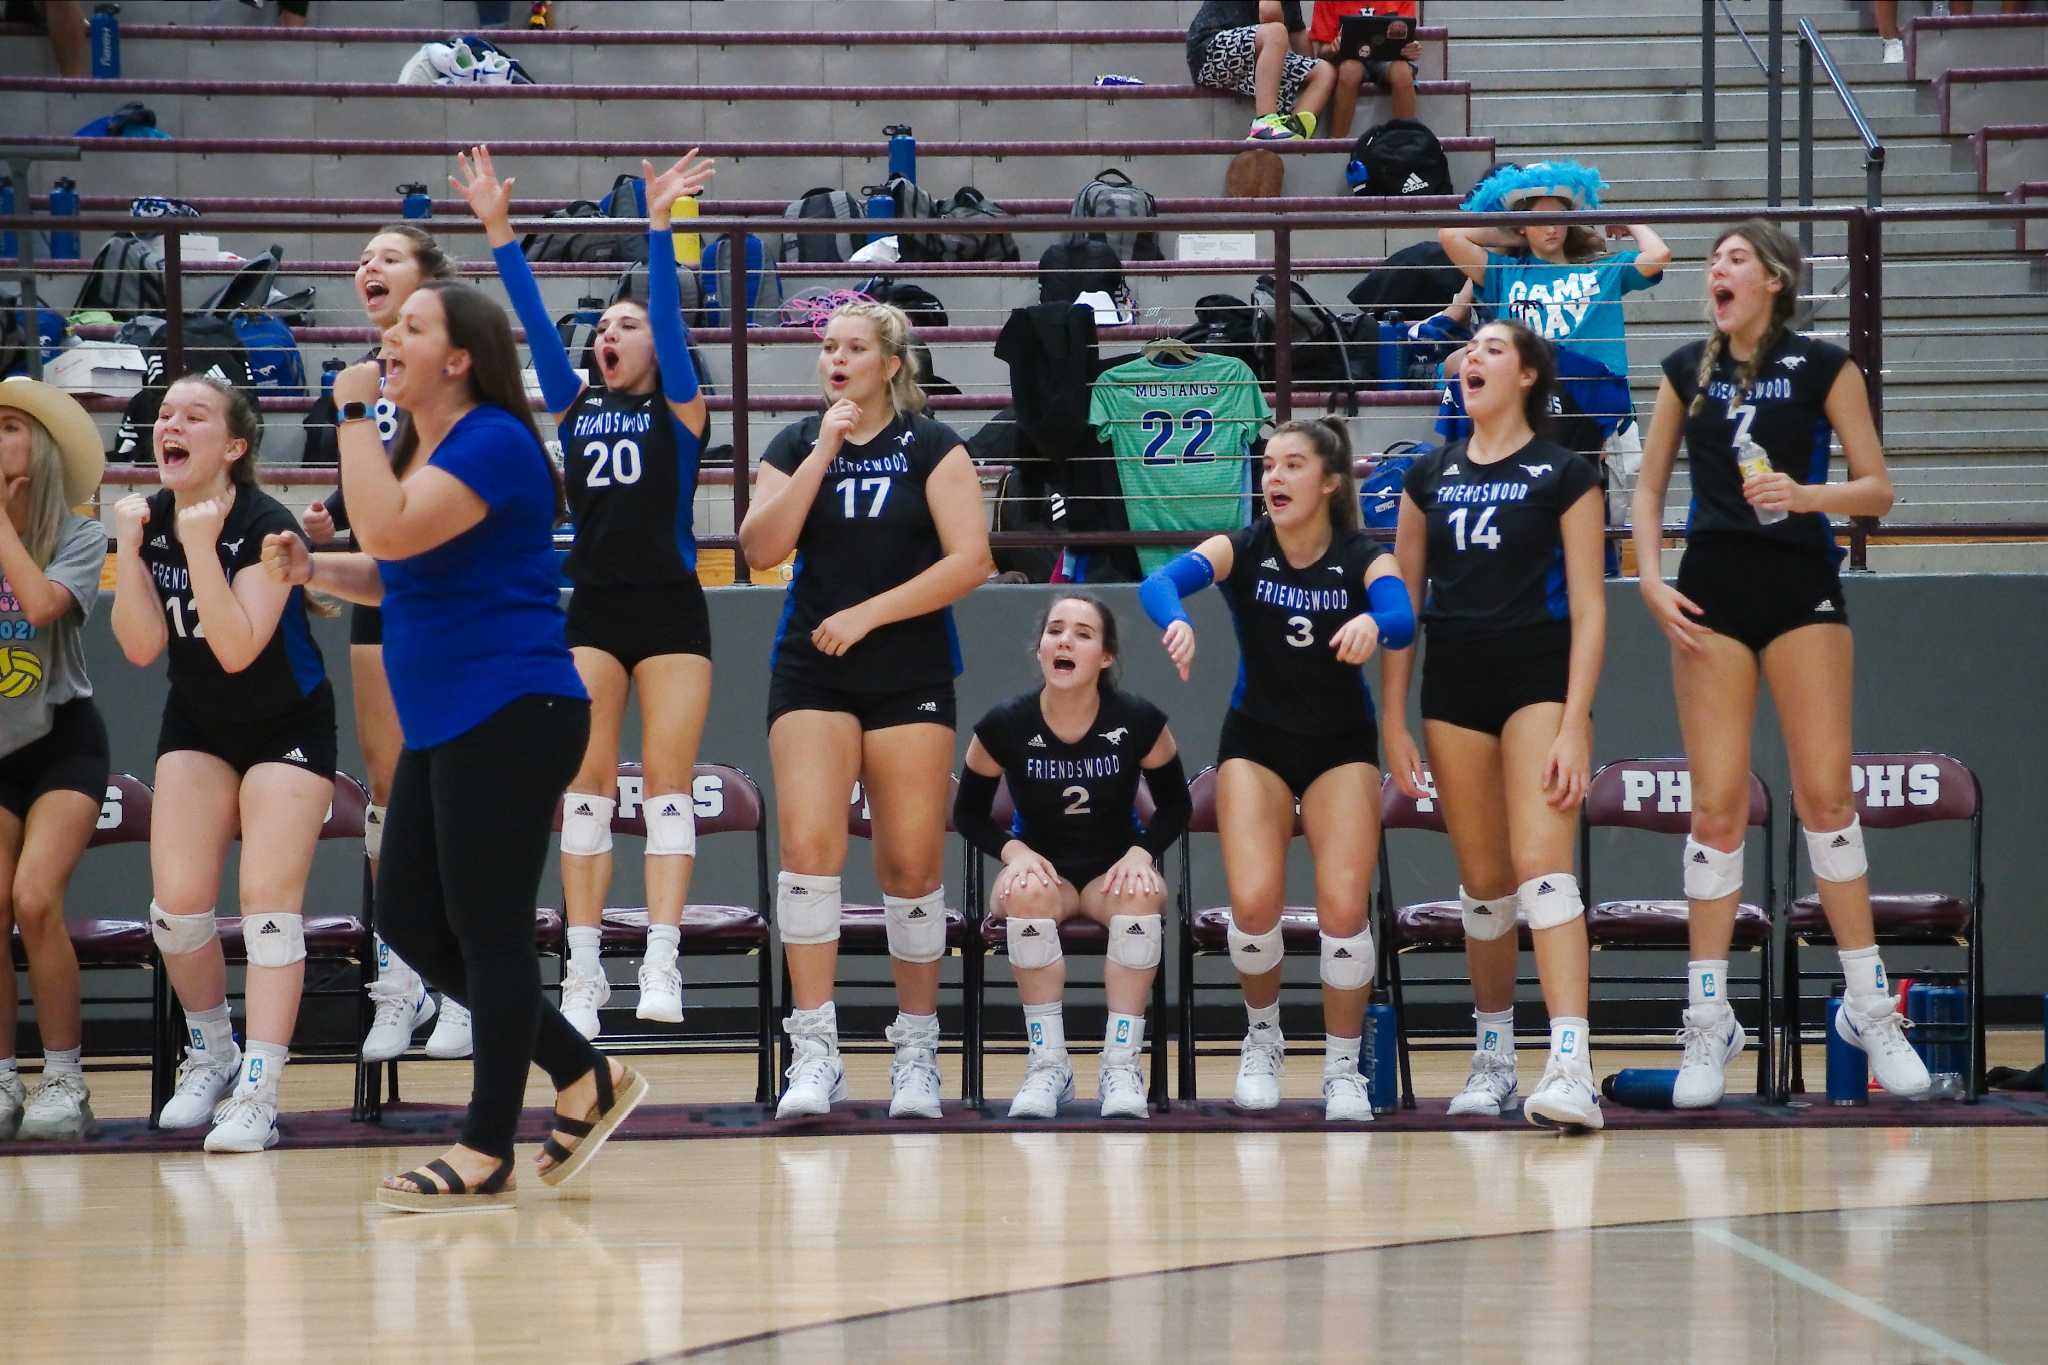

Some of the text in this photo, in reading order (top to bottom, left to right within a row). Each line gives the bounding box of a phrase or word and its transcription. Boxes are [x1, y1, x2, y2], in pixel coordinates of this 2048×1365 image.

[1509, 270, 1600, 304] GAME
[1135, 383, 1218, 397] MUSTANGS
[1141, 407, 1217, 467] 22
[1727, 404, 1757, 448] 7
[583, 439, 642, 487] 20
[836, 476, 891, 518] 17
[1437, 482, 1528, 503] FRIENDSWOOD
[1448, 506, 1501, 551] 14
[1255, 579, 1348, 611] FRIENDSWOOD
[1286, 615, 1314, 648] 3
[1027, 754, 1120, 780] FRIENDSWOOD
[617, 775, 723, 818] PS
[1062, 785, 1091, 815] 2
[1621, 769, 1692, 813] PH
